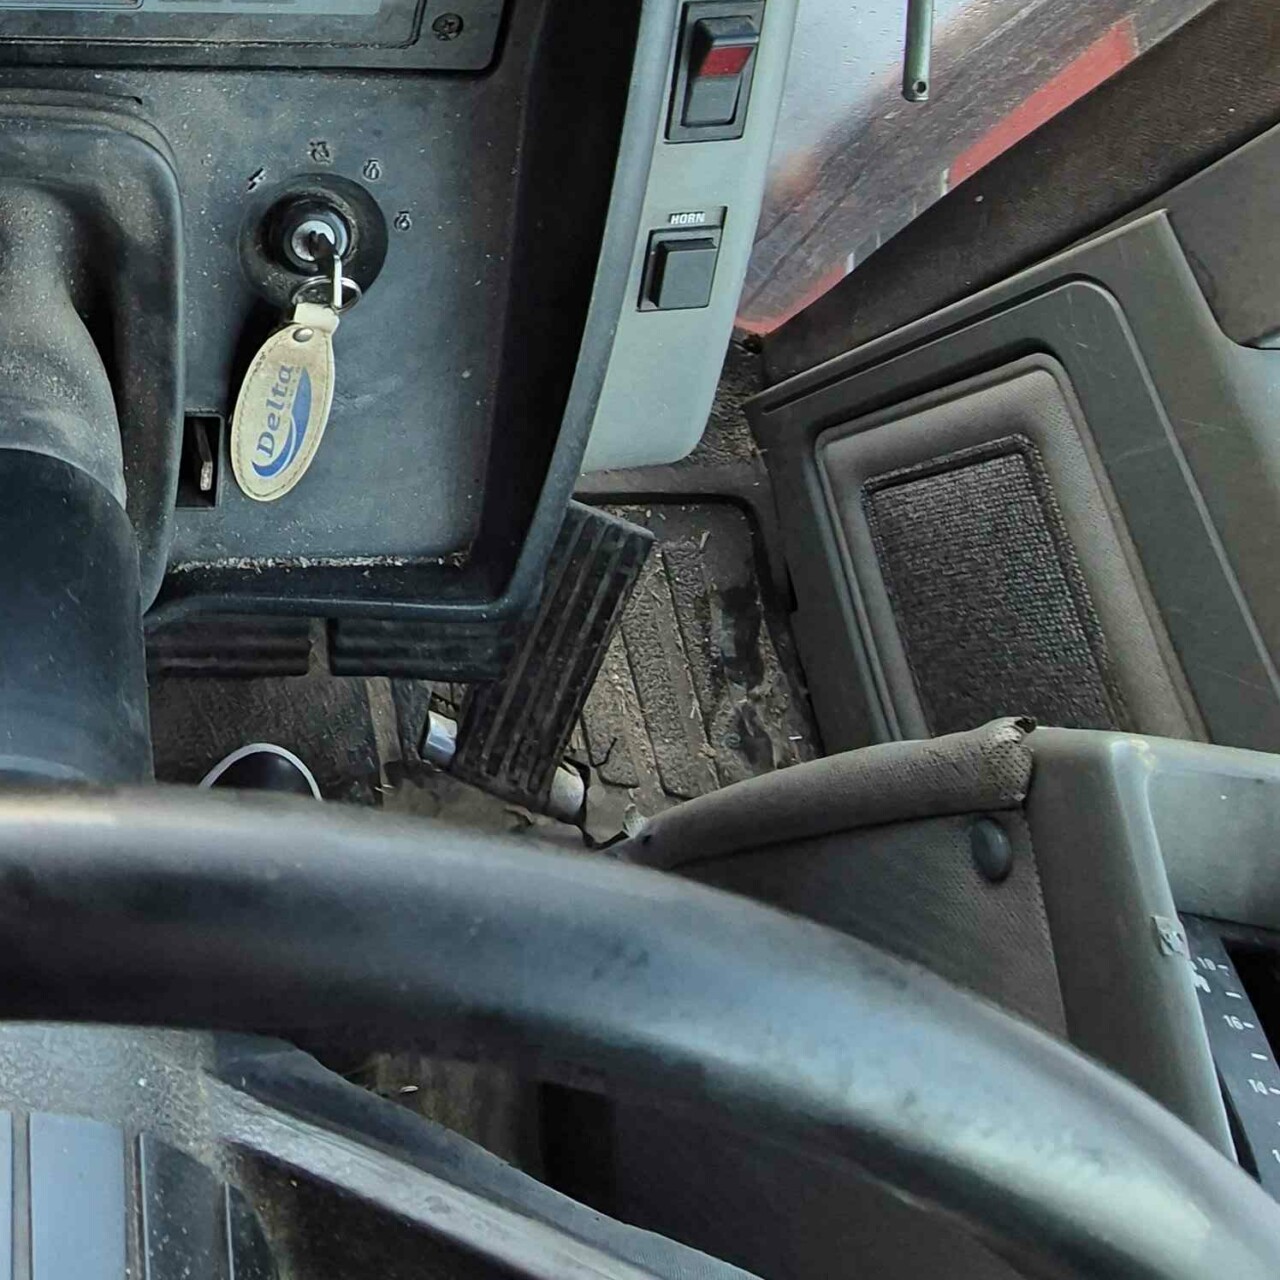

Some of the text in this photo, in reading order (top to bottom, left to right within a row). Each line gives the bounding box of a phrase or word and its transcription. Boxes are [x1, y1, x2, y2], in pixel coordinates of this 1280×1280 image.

[670, 212, 706, 225] HORN
[257, 364, 294, 459] Delta
[1223, 1014, 1245, 1030] 16
